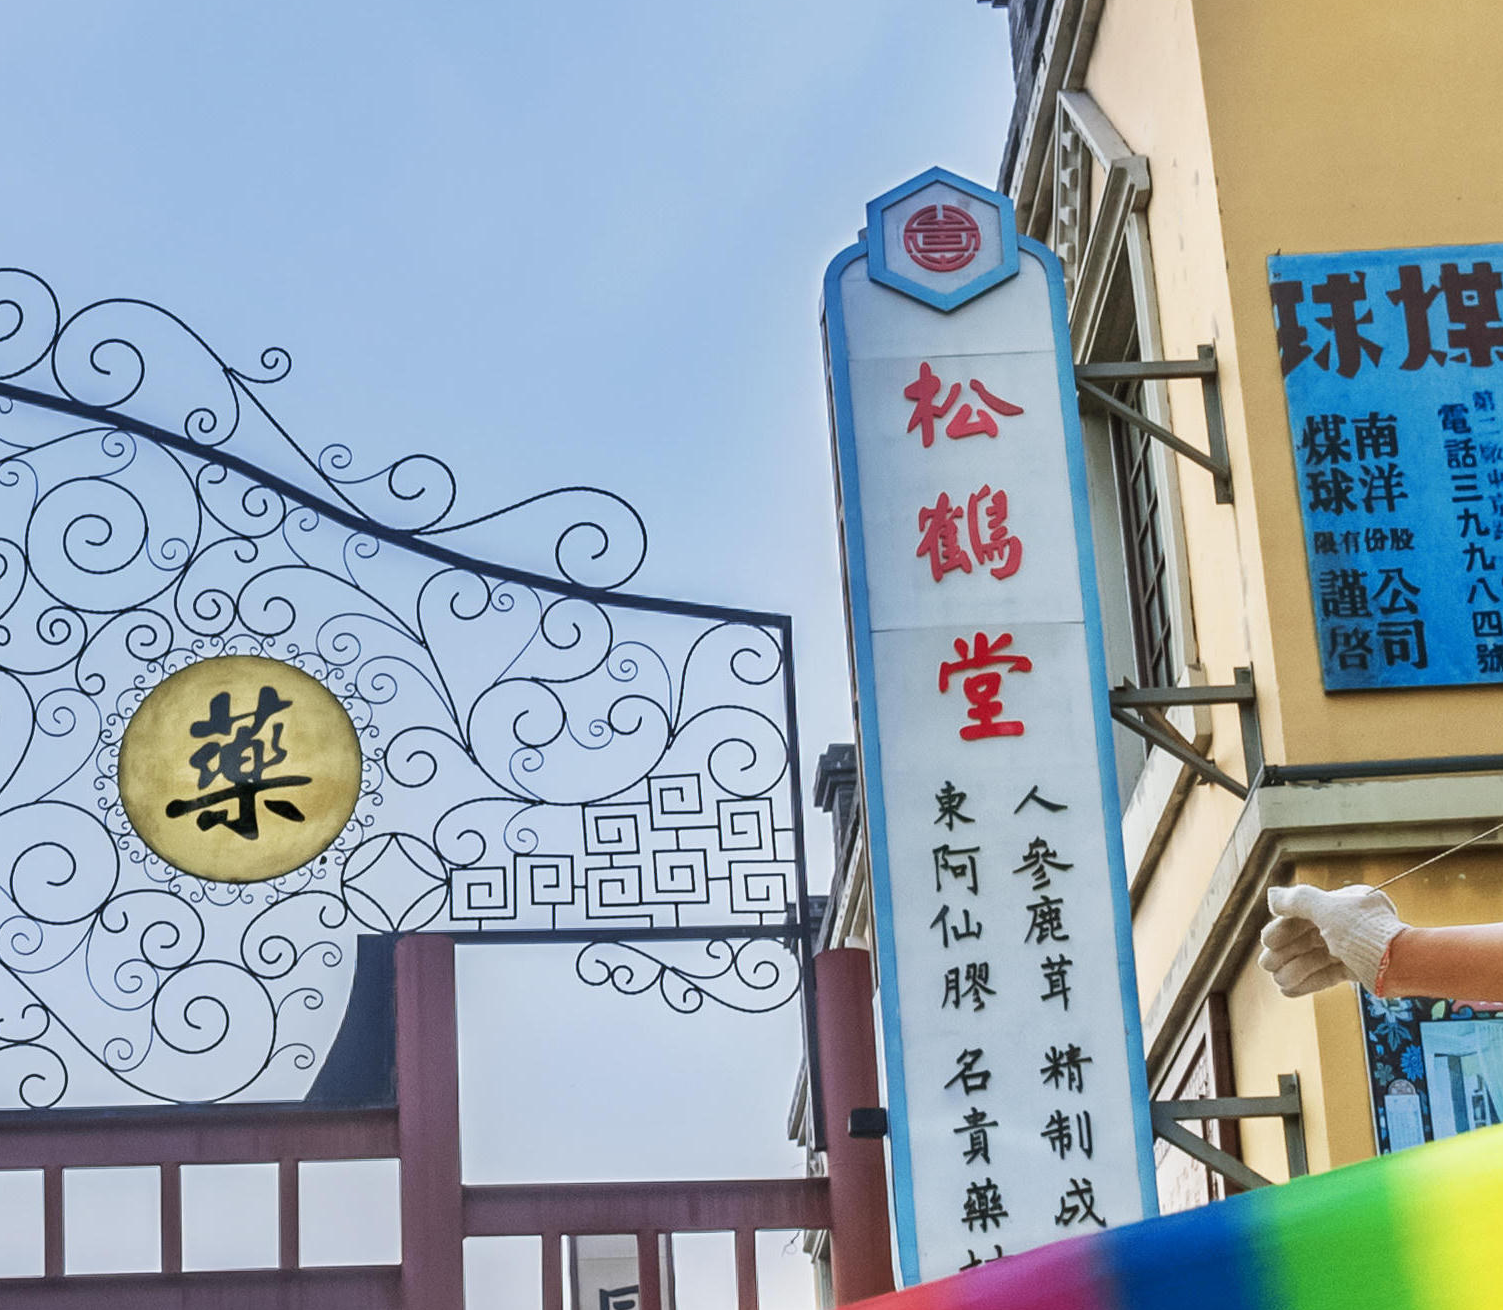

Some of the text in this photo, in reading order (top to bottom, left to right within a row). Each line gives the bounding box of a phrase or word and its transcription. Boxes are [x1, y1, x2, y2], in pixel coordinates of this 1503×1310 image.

[1300, 413, 1358, 516] 煤球
[1351, 411, 1409, 514] 南洋
[903, 361, 1033, 741] 松鶴堂
[1371, 567, 1429, 670] 公司
